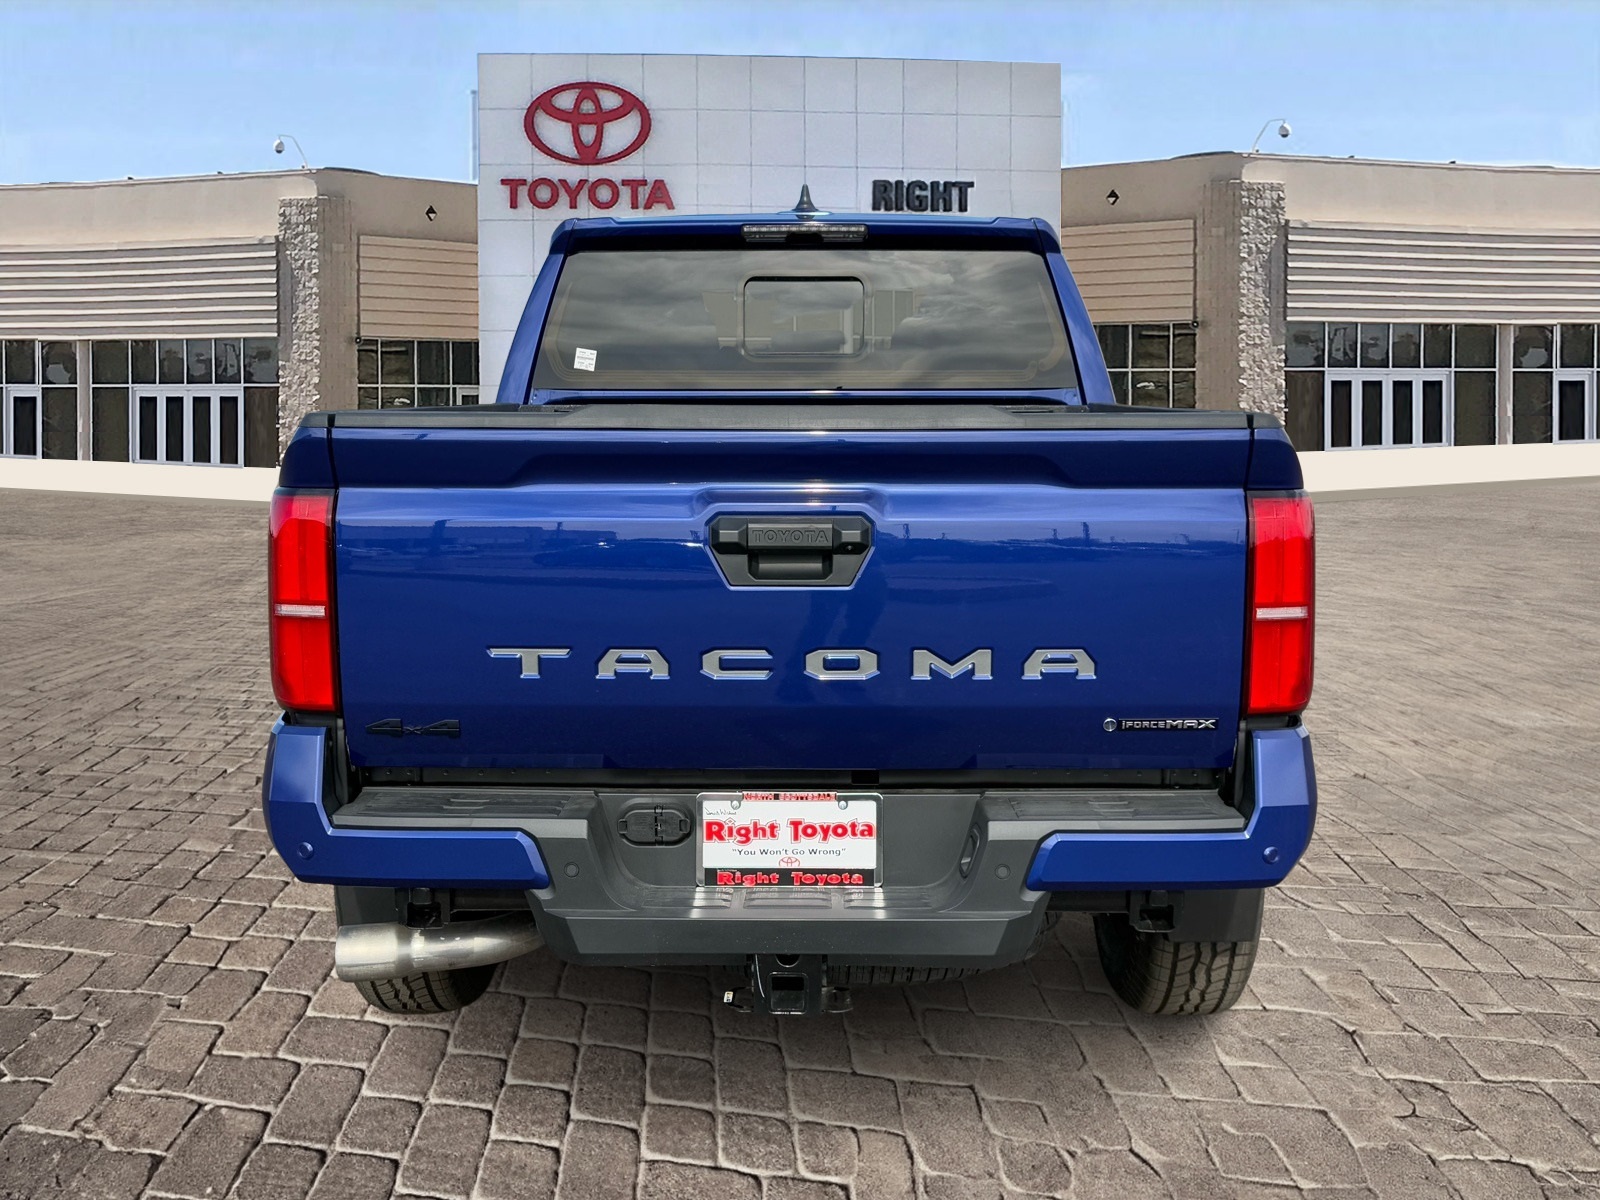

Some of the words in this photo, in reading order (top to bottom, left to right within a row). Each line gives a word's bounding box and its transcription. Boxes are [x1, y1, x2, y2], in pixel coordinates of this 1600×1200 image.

[500, 178, 675, 210] TOYOTA
[871, 179, 975, 212] RIGHT
[751, 529, 829, 544] TOYOTA
[487, 648, 1097, 680] TACOMA
[704, 819, 779, 845] Right
[788, 819, 875, 843] Toyota
[759, 848, 788, 856] Won't
[791, 848, 805, 856] Go
[717, 871, 779, 887] Right
[791, 871, 863, 886] Toyota
